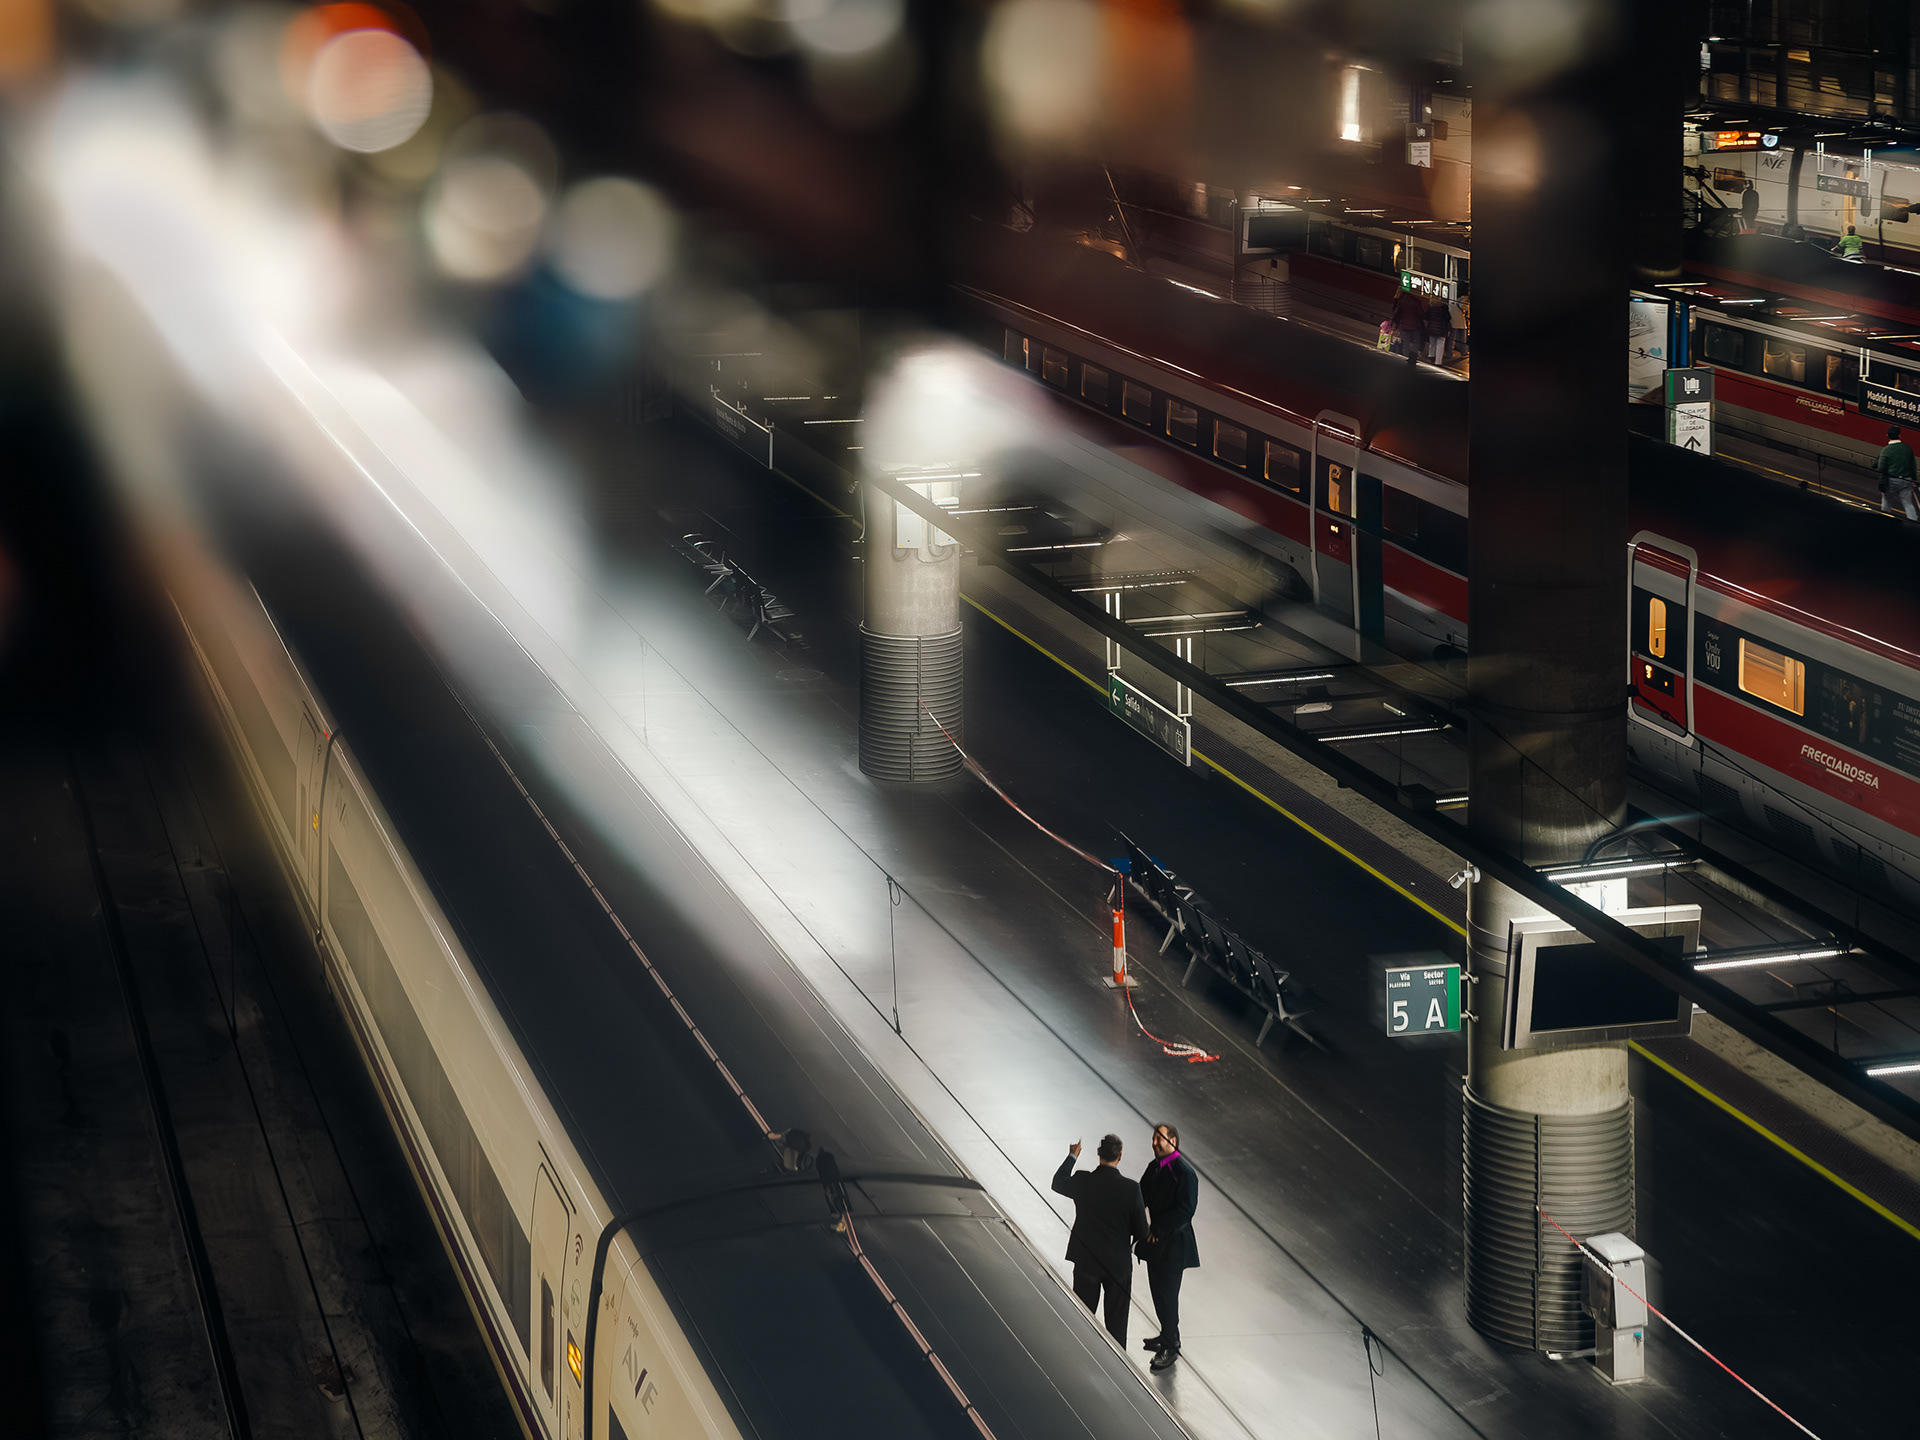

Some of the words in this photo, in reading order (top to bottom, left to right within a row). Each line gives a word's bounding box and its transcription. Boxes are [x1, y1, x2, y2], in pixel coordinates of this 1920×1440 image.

[1762, 158, 1787, 170] AVE
[1867, 390, 1887, 404] Madrid
[1888, 396, 1907, 409] Puerta
[1908, 402, 1916, 412] de
[1867, 401, 1895, 417] Almudena
[1896, 409, 1920, 424] Grandes
[1706, 652, 1721, 670] YOU
[1125, 693, 1140, 713] Salida
[1801, 744, 1879, 790] FRECCIAROSSA
[1389, 981, 1411, 989] PLATFORM
[1423, 971, 1445, 980] Sector
[1393, 1000, 1409, 1032] 5
[1425, 997, 1445, 1029] A
[622, 1342, 659, 1416] AVE
